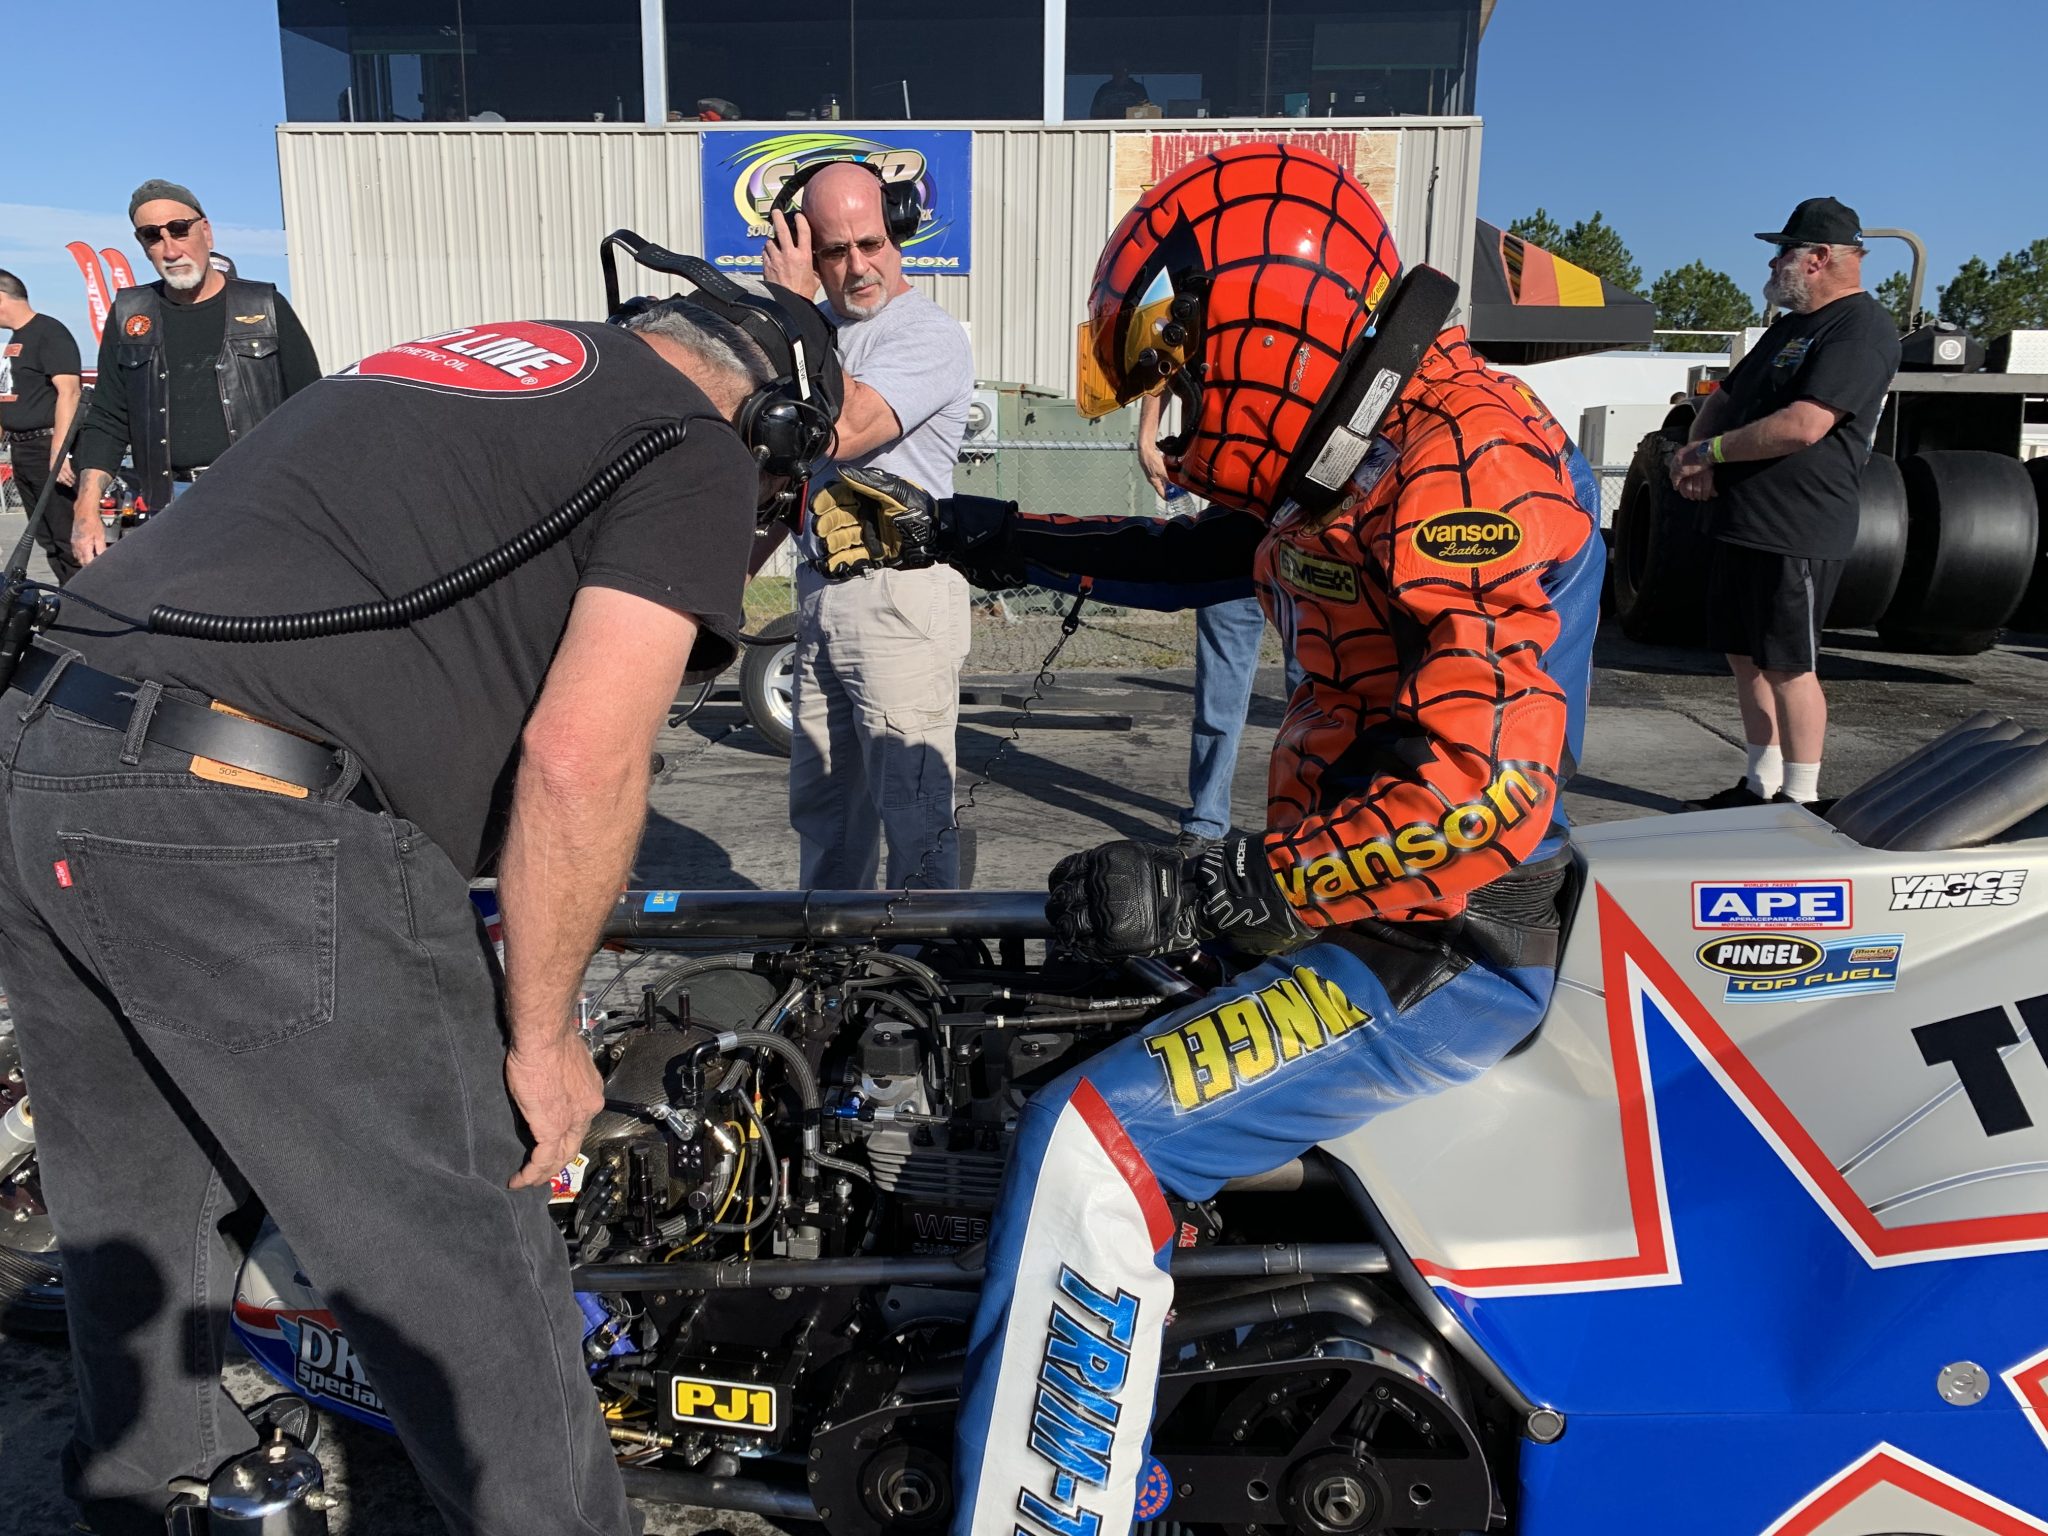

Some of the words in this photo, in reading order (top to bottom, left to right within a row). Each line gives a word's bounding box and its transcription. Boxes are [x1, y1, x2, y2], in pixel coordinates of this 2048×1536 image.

[441, 333, 573, 378] LINE
[443, 358, 469, 372] OIL
[798, 360, 807, 380] STEVE
[1423, 523, 1514, 542] vanson
[1439, 542, 1498, 556] Leathers
[219, 767, 238, 777] 505
[1275, 767, 1540, 907] vanson
[1236, 838, 1247, 877] RACER
[1891, 869, 2028, 894] VANCE
[1709, 892, 1836, 917] APE
[1889, 887, 2021, 911] HINES
[1717, 944, 1803, 965] PINGEL
[1733, 978, 1797, 991] TOP
[1804, 967, 1894, 987] FUEL
[1146, 964, 1371, 1113] PINGEL
[678, 1382, 770, 1425] PJ1
[1015, 1262, 1141, 1536] TRIM-T
[1139, 1465, 1168, 1518] BEARINGS
